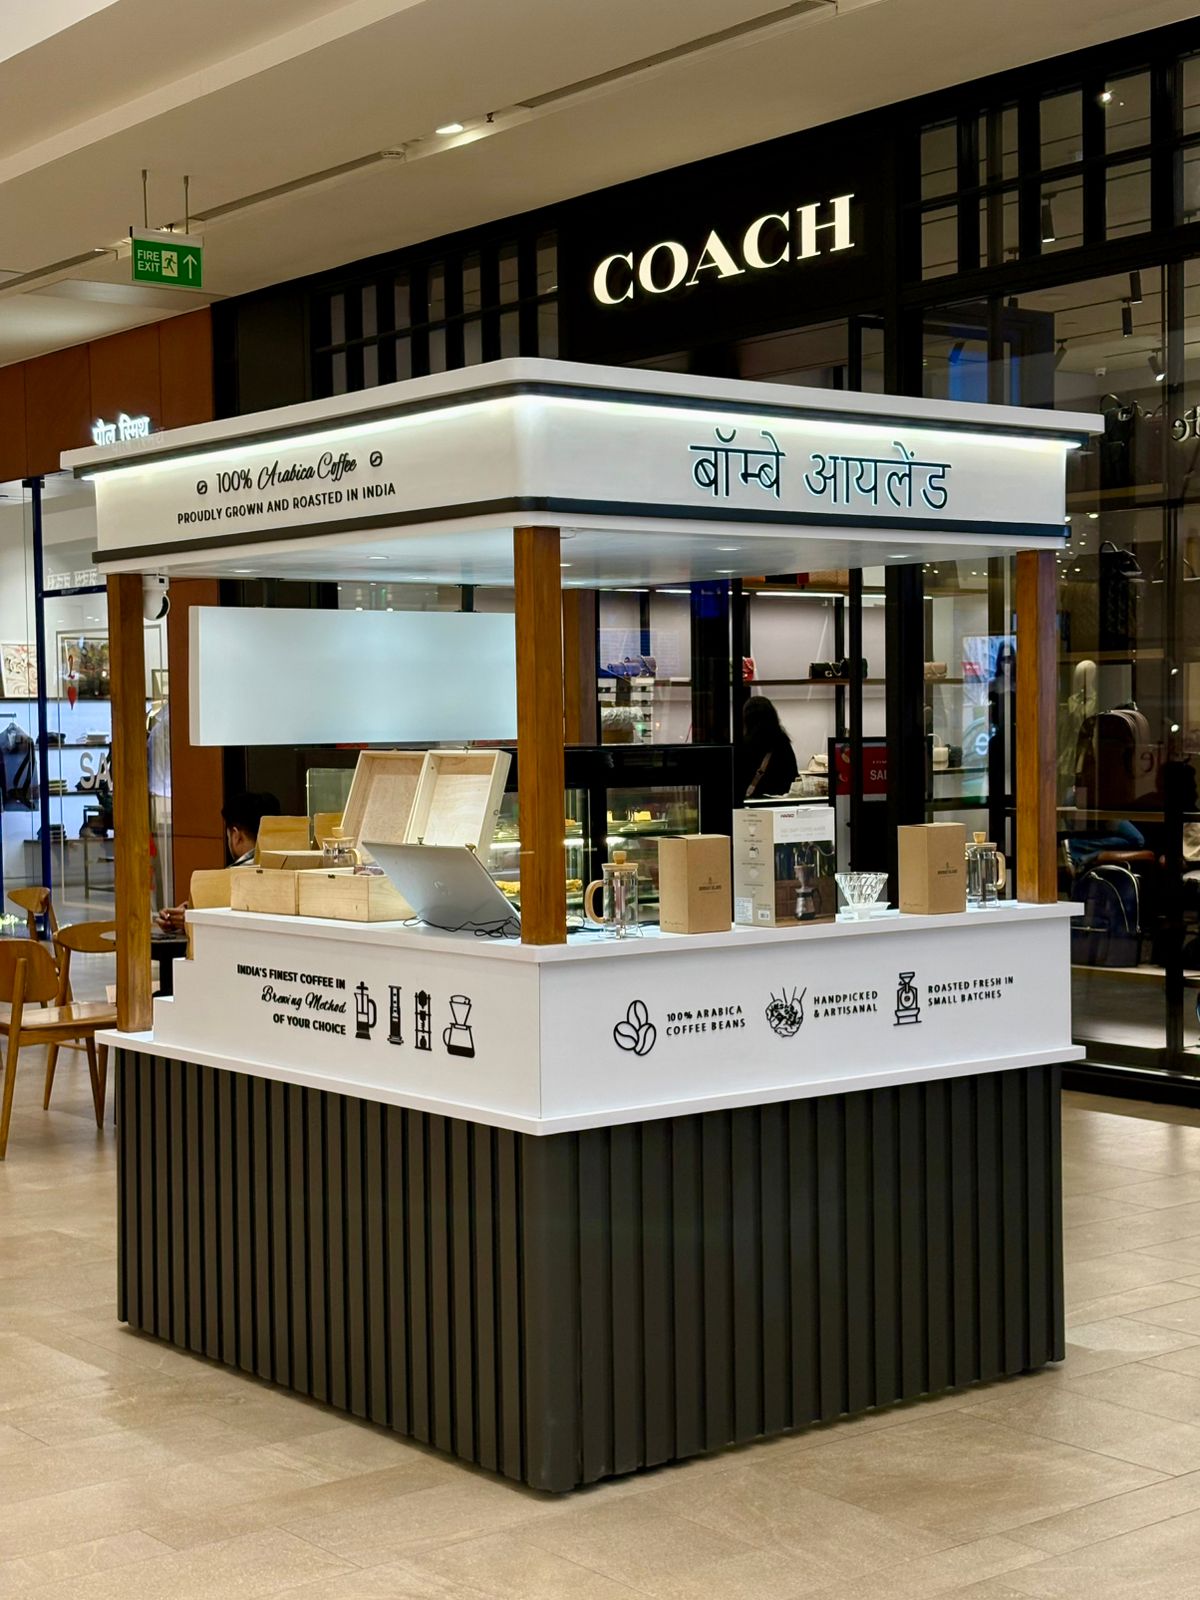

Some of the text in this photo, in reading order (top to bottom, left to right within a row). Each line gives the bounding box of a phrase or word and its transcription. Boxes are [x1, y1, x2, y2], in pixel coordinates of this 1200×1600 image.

[137, 249, 160, 262] FIRE
[593, 193, 855, 305] COACH
[137, 260, 160, 273] EXIT
[216, 451, 357, 493] 100% Arabica Coffee
[689, 427, 952, 510] बॉम्बे आयलेंड
[177, 482, 396, 524] PROUDLY GROWN AND ROASTED IN INDIA
[236, 963, 346, 989] INDIA'S FINEST COFFEE IN
[927, 975, 1014, 994] ROASTED FRESH IN
[261, 984, 347, 1014] Brewing Method
[813, 990, 879, 1006] HANDPICKED
[927, 989, 1002, 1007] SMALL BATCHES
[666, 1004, 743, 1023] 100% ARABICA
[813, 1003, 878, 1019] & ARTISANAL
[272, 1013, 347, 1035] OF YOUR CHOICE
[665, 1018, 747, 1037] COFFEE BEANS
